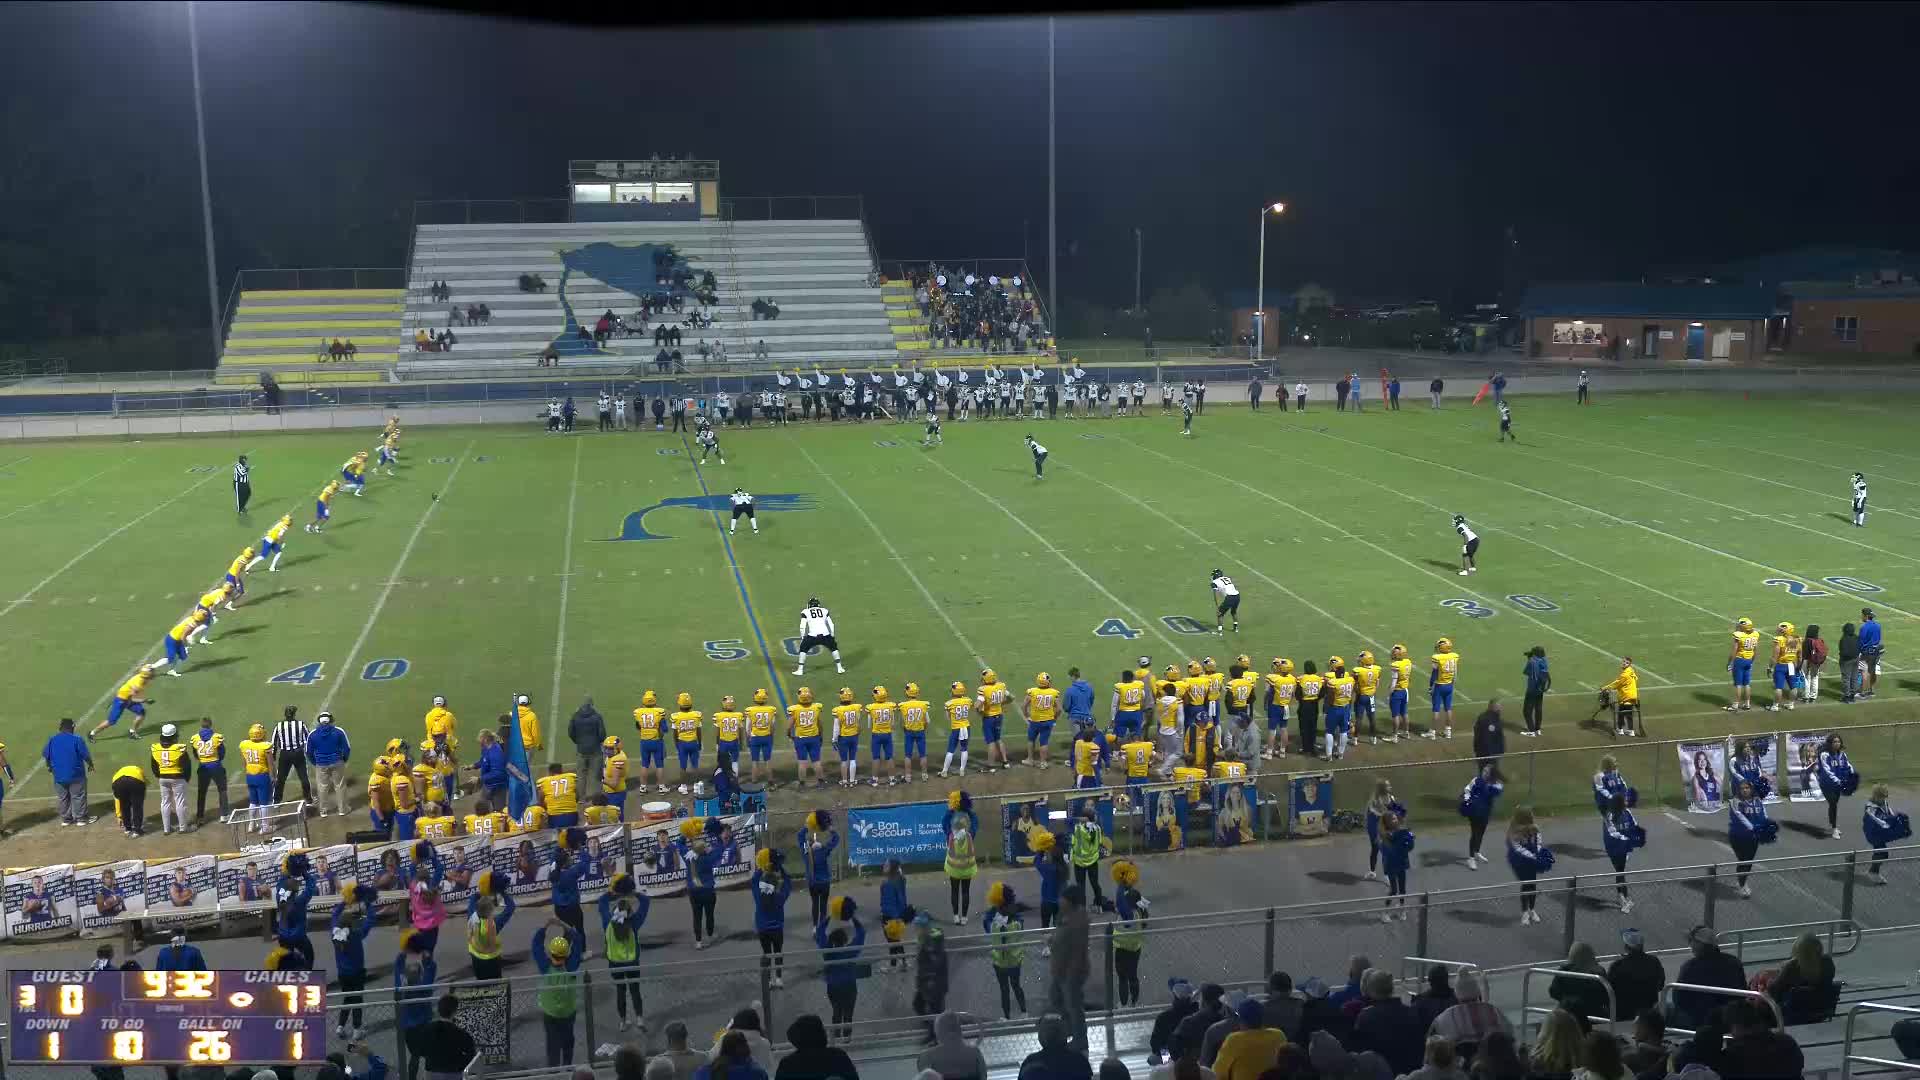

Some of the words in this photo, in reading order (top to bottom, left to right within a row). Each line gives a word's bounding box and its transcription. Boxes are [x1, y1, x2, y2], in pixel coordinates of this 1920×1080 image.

[810, 609, 823, 618] 60
[1237, 686, 1248, 700] 12
[641, 713, 655, 728] 13
[756, 712, 769, 727] 21
[908, 708, 922, 721] 87
[722, 717, 738, 732] 33
[198, 741, 213, 755] 22
[551, 778, 568, 796] 77
[474, 818, 492, 835] 59
[878, 821, 898, 830] Bon
[871, 828, 912, 838] Secours
[856, 847, 884, 855] Sports
[14, 916, 71, 934] HURRICANE
